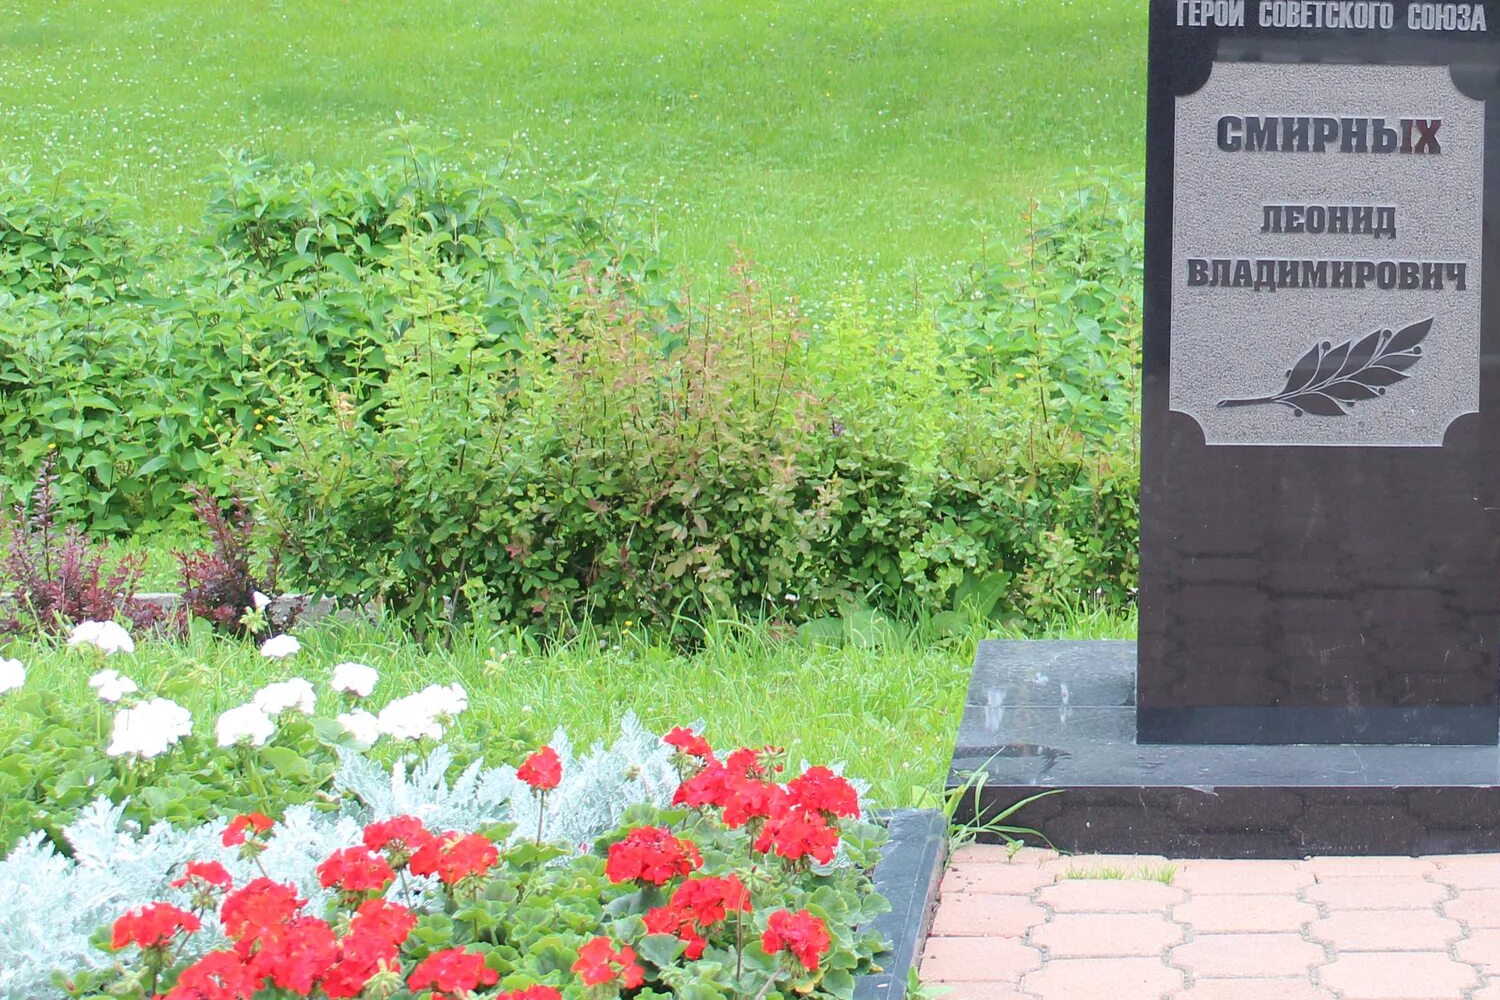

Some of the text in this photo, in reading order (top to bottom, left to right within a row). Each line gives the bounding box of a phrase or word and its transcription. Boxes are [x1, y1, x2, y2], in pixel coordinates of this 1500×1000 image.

[1258, 0, 1394, 29] СОВЕТСКОГО
[1407, 2, 1487, 31] СОЮЗА
[1216, 115, 1442, 154] СМИРНЫХ
[1260, 205, 1397, 239] ЛЕОНИД
[1187, 258, 1467, 292] ВЛАДИМИРОВИЧ
